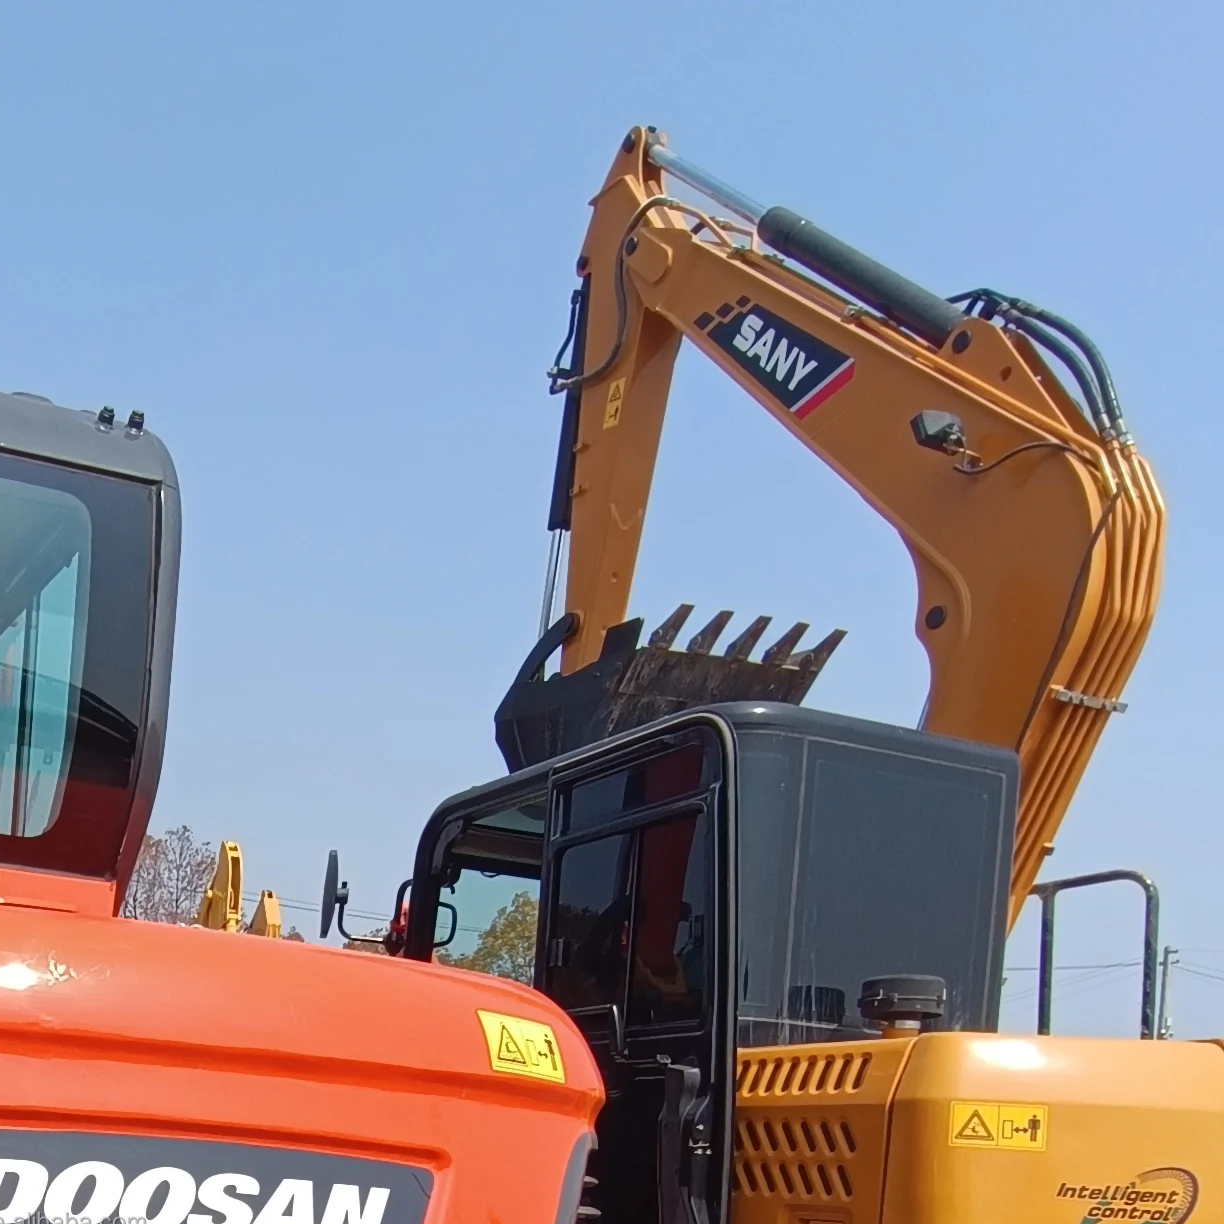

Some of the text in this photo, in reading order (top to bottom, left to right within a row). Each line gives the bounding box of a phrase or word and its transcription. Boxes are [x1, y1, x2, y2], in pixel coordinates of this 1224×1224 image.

[732, 313, 819, 391] SANY
[1056, 1182, 1179, 1206] Intelligent
[1087, 1206, 1173, 1222] control
